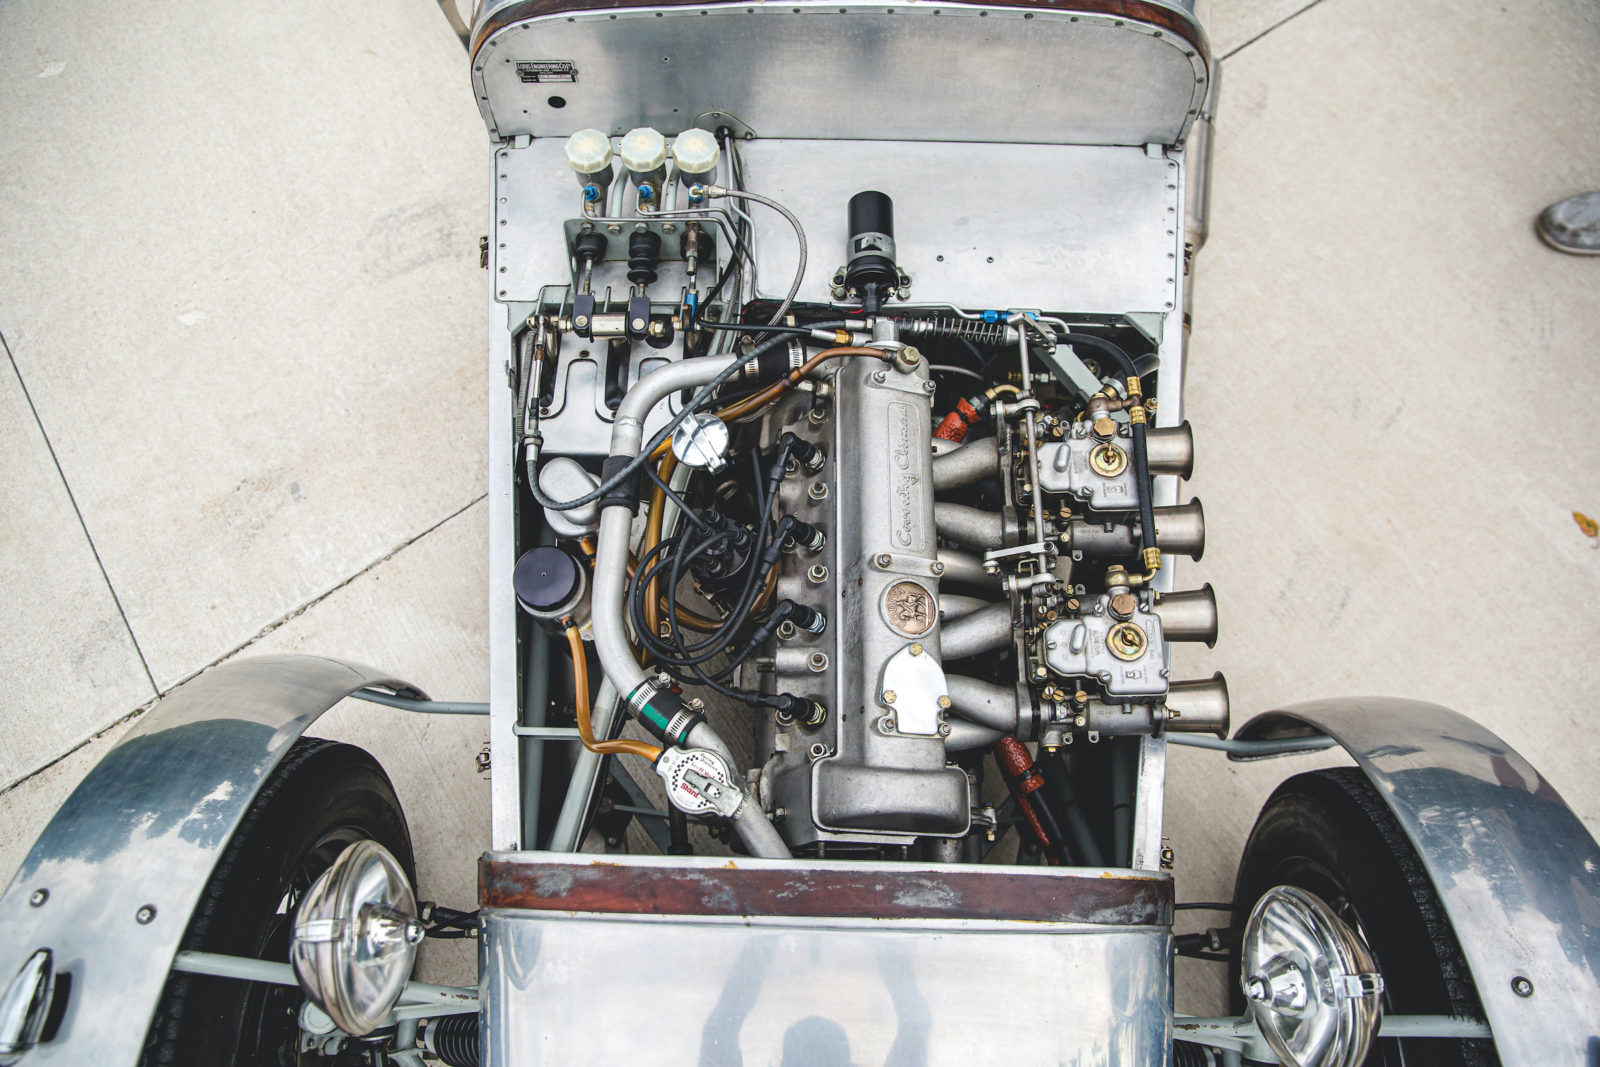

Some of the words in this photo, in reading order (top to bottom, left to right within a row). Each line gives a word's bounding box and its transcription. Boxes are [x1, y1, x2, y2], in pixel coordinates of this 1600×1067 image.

[896, 473, 920, 547] Coventry
[888, 587, 906, 628] GODIVA
[680, 782, 700, 798] Stant
